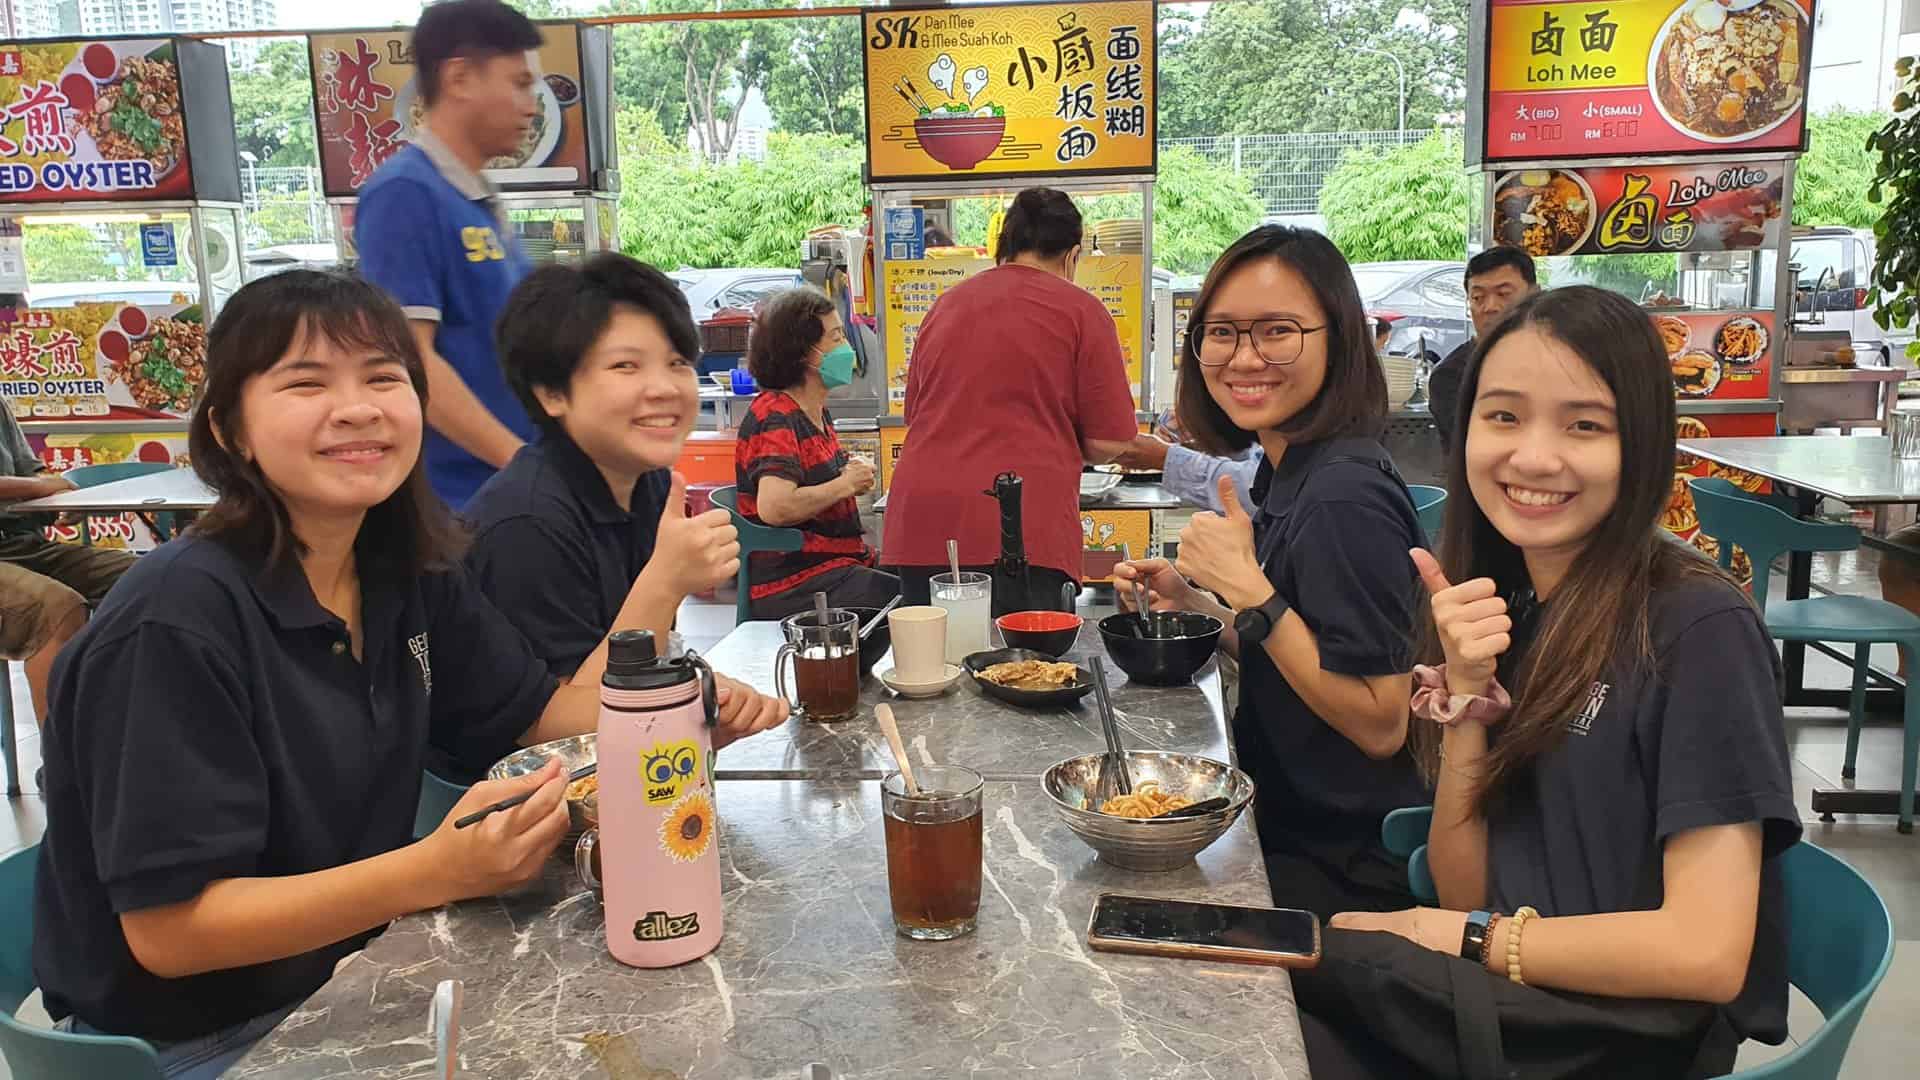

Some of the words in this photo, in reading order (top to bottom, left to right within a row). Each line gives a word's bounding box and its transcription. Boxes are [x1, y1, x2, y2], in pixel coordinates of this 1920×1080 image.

[925, 15, 946, 30] Pan
[949, 14, 974, 29] Mee
[871, 16, 921, 49] SK
[933, 33, 958, 48] Mee
[960, 32, 989, 47] Suah
[992, 31, 1013, 46] Koh
[1532, 9, 1618, 56] 卤面
[1106, 26, 1145, 137] 面线糊
[1528, 64, 1563, 82] Loh
[1571, 64, 1616, 80] Mee
[1516, 104, 1529, 120] 大
[1532, 106, 1559, 120] (BIG)
[1583, 101, 1598, 118] 小
[1600, 104, 1643, 118] (SMALL)
[1056, 84, 1096, 161] 板面
[1510, 132, 1526, 141] RM
[1584, 129, 1600, 139] RM
[43, 161, 153, 190] OYSTER
[1667, 178, 1713, 207] Loh
[1717, 167, 1766, 190] Mee
[1, 331, 84, 377] 蠔煎
[44, 381, 105, 394] OYSTER
[648, 784, 675, 799] SAW
[640, 914, 698, 938] allez
